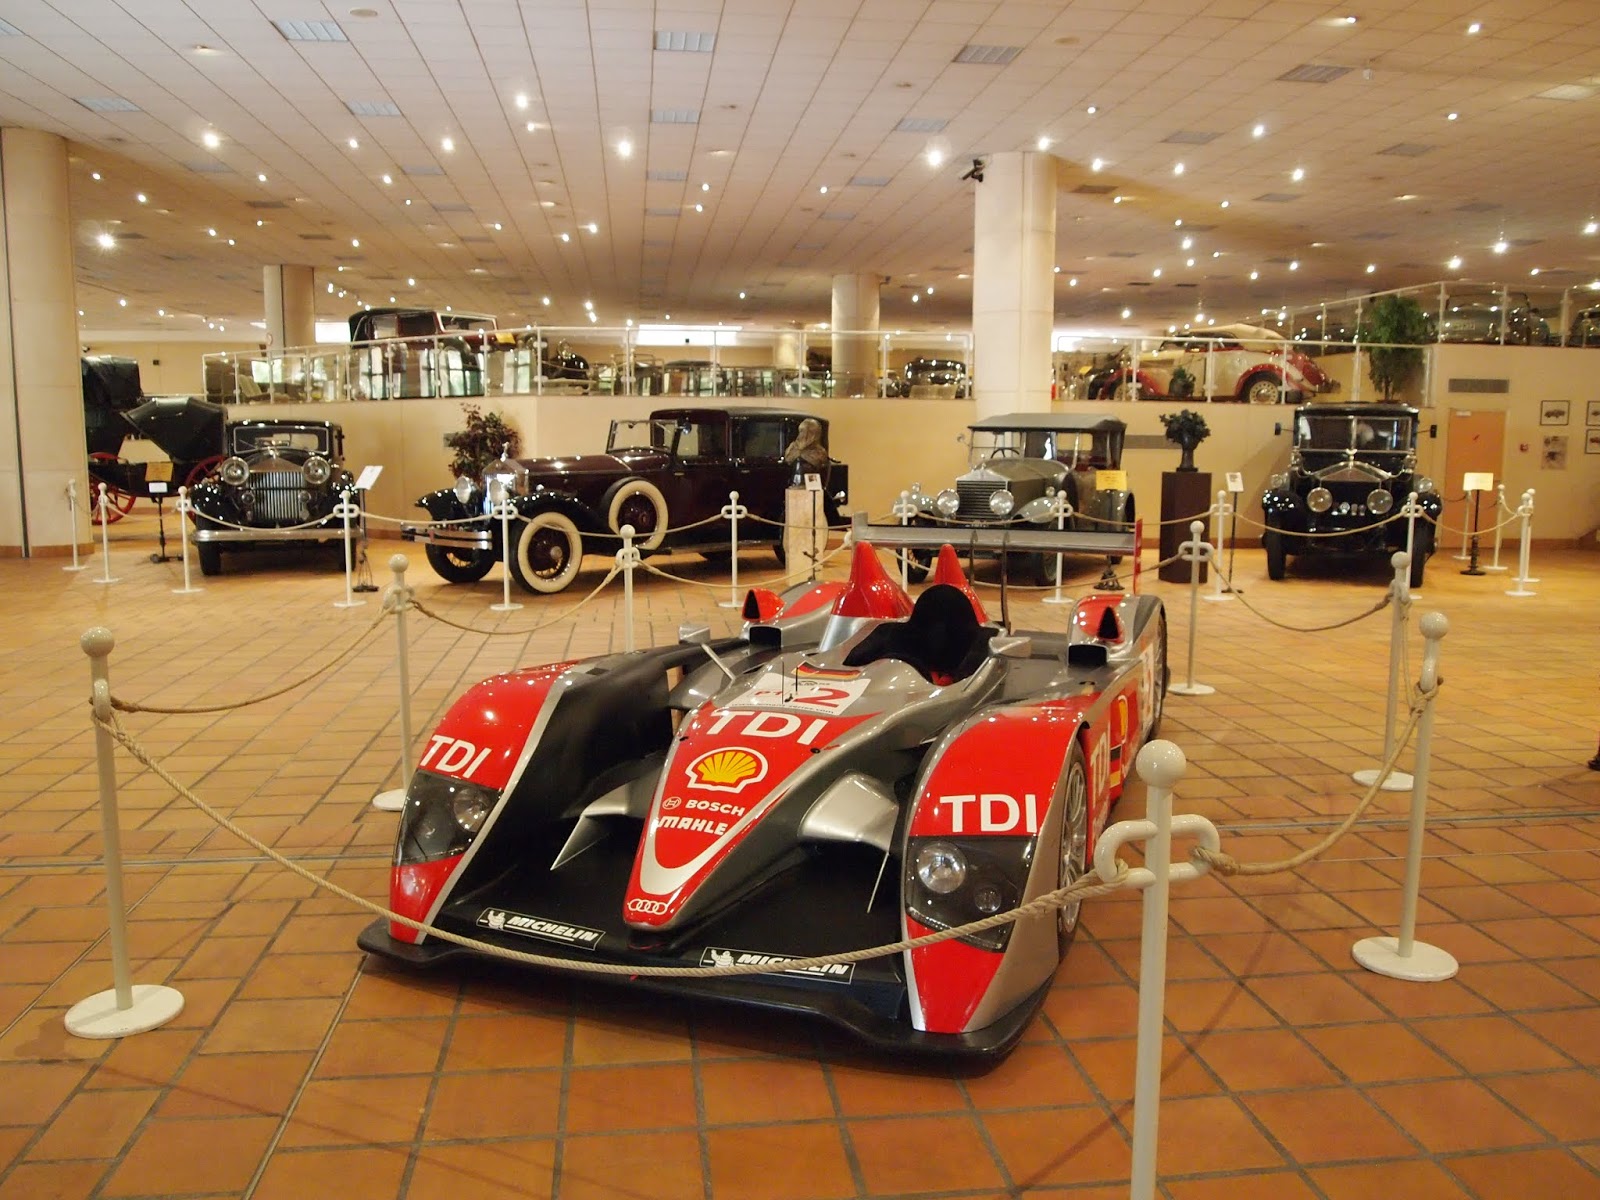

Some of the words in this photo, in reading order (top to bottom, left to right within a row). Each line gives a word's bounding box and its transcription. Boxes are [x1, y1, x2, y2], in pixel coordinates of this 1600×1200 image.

[792, 687, 850, 709] 2
[706, 709, 828, 746] TDI
[420, 734, 492, 779] TDI
[685, 799, 745, 817] BOSCH
[939, 793, 1038, 833] TDI
[659, 816, 728, 836] MAHLE
[507, 916, 599, 942] MICHELIN
